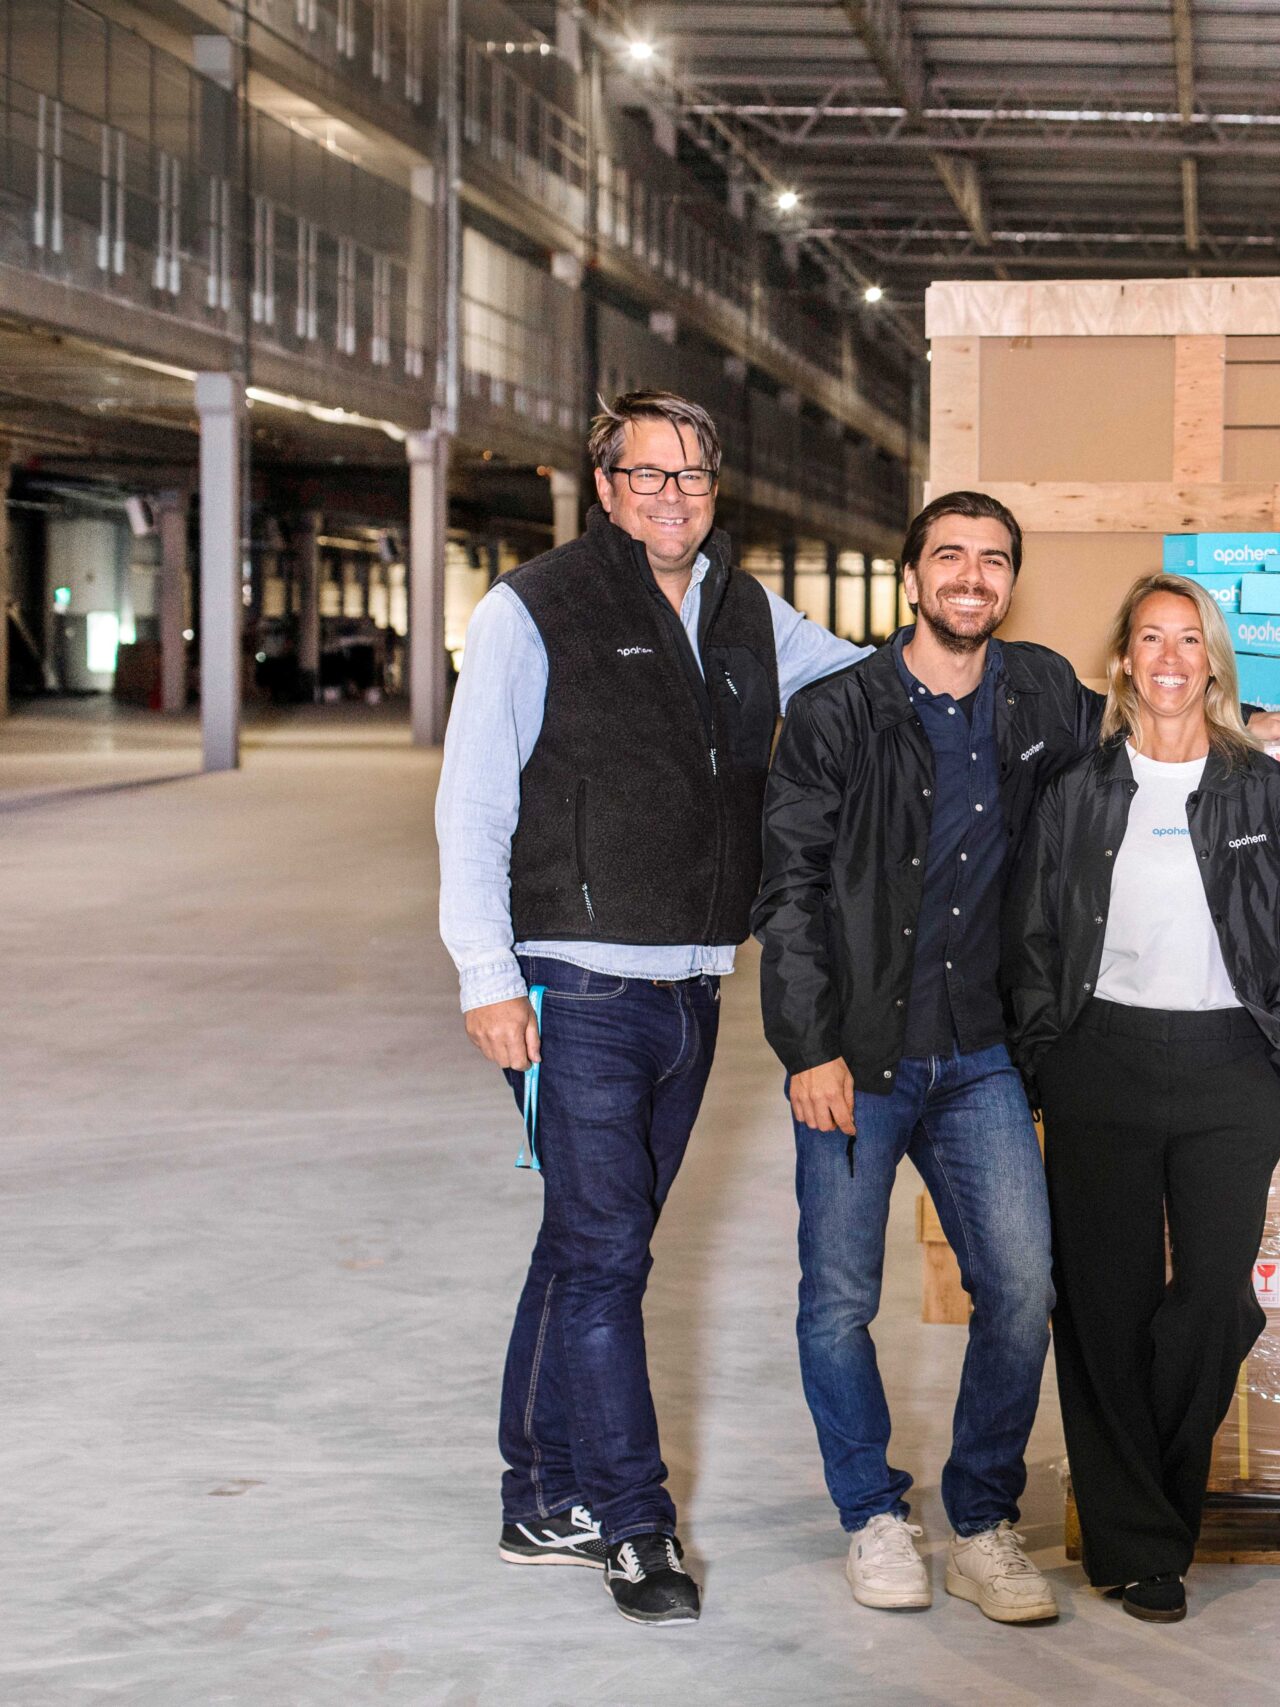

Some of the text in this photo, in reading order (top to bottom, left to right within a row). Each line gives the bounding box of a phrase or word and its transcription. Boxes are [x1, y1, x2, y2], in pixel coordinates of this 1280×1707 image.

[1020, 740, 1045, 762] apohem
[1152, 826, 1190, 838] apohe
[1228, 832, 1267, 850] apohem
